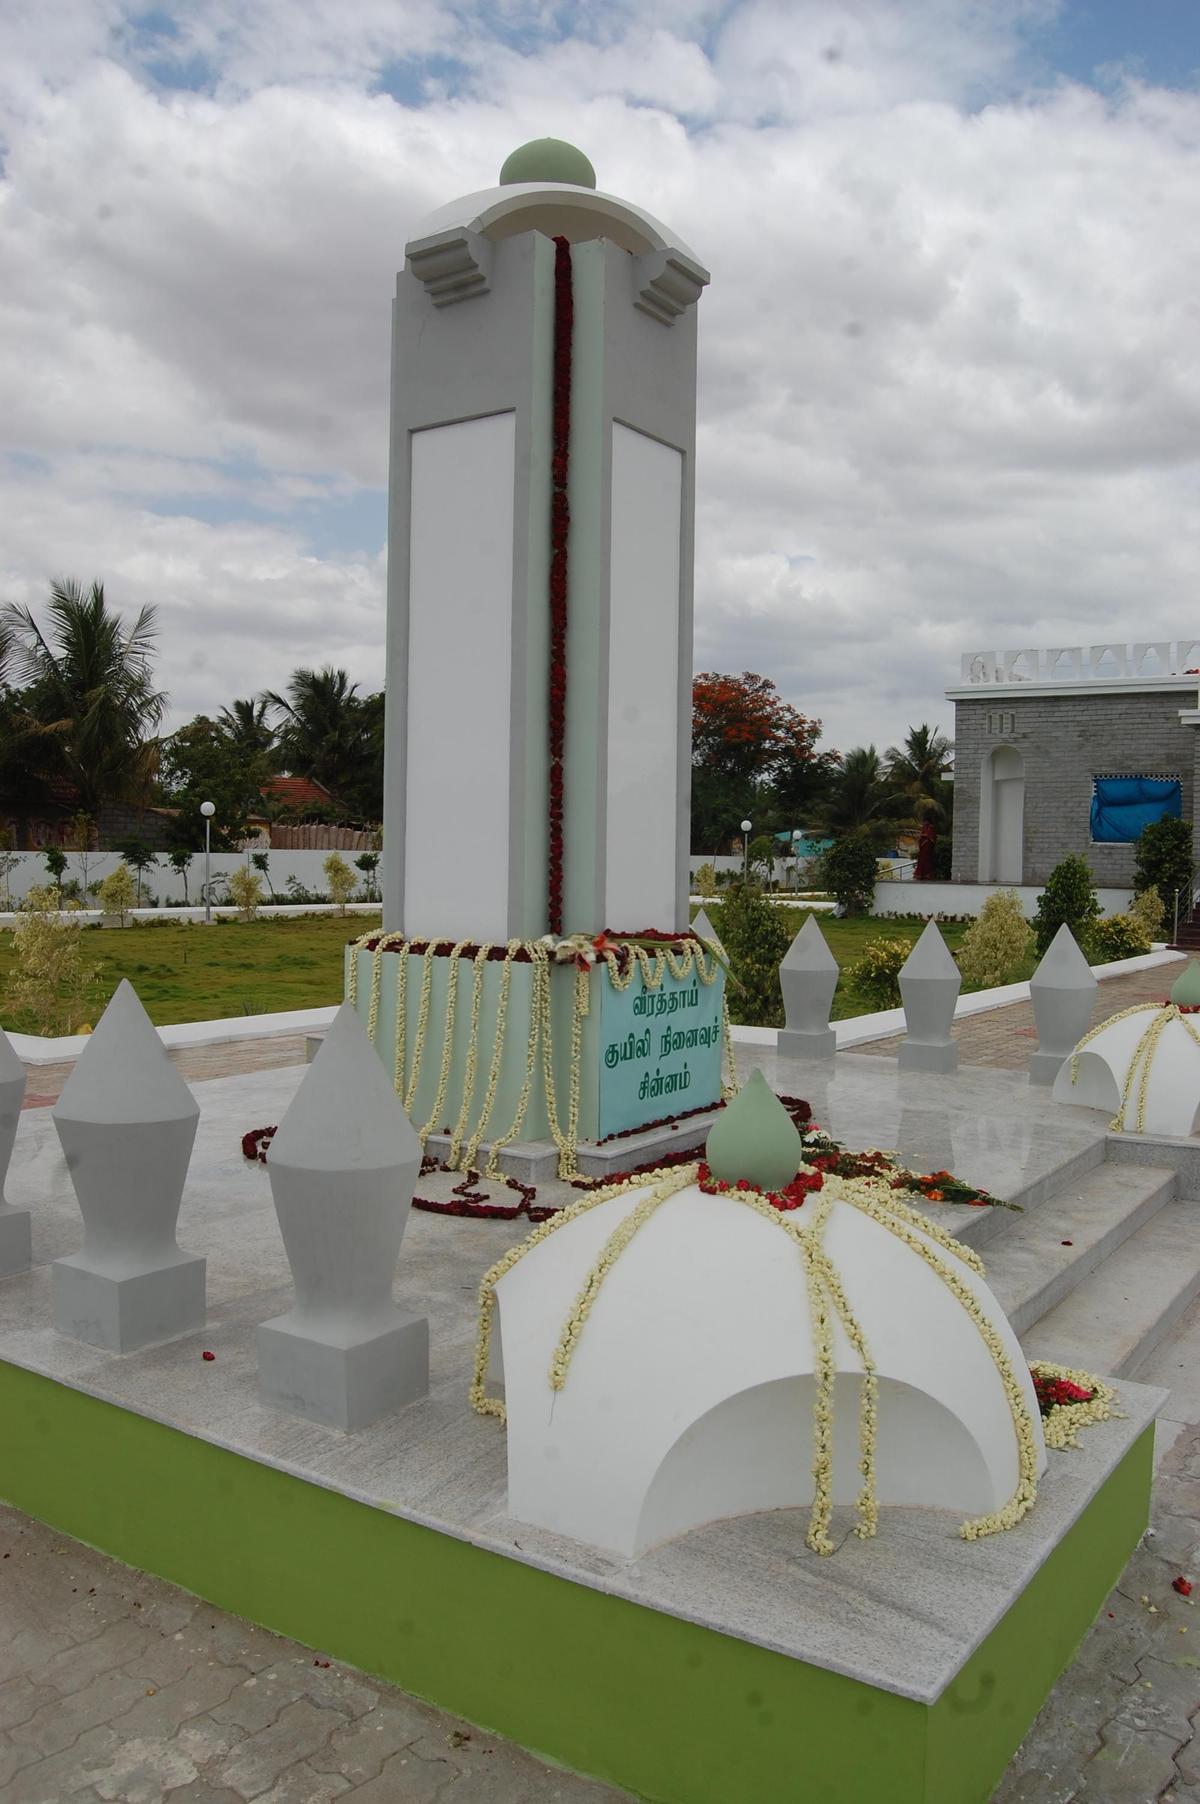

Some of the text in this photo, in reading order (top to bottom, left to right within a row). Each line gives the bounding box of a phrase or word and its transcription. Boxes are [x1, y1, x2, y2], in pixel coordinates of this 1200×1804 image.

[633, 979, 699, 1018] வீரத்தாய்
[604, 1016, 720, 1068] குயிலி நினைவுச்
[638, 1062, 691, 1100] சின்னம்
